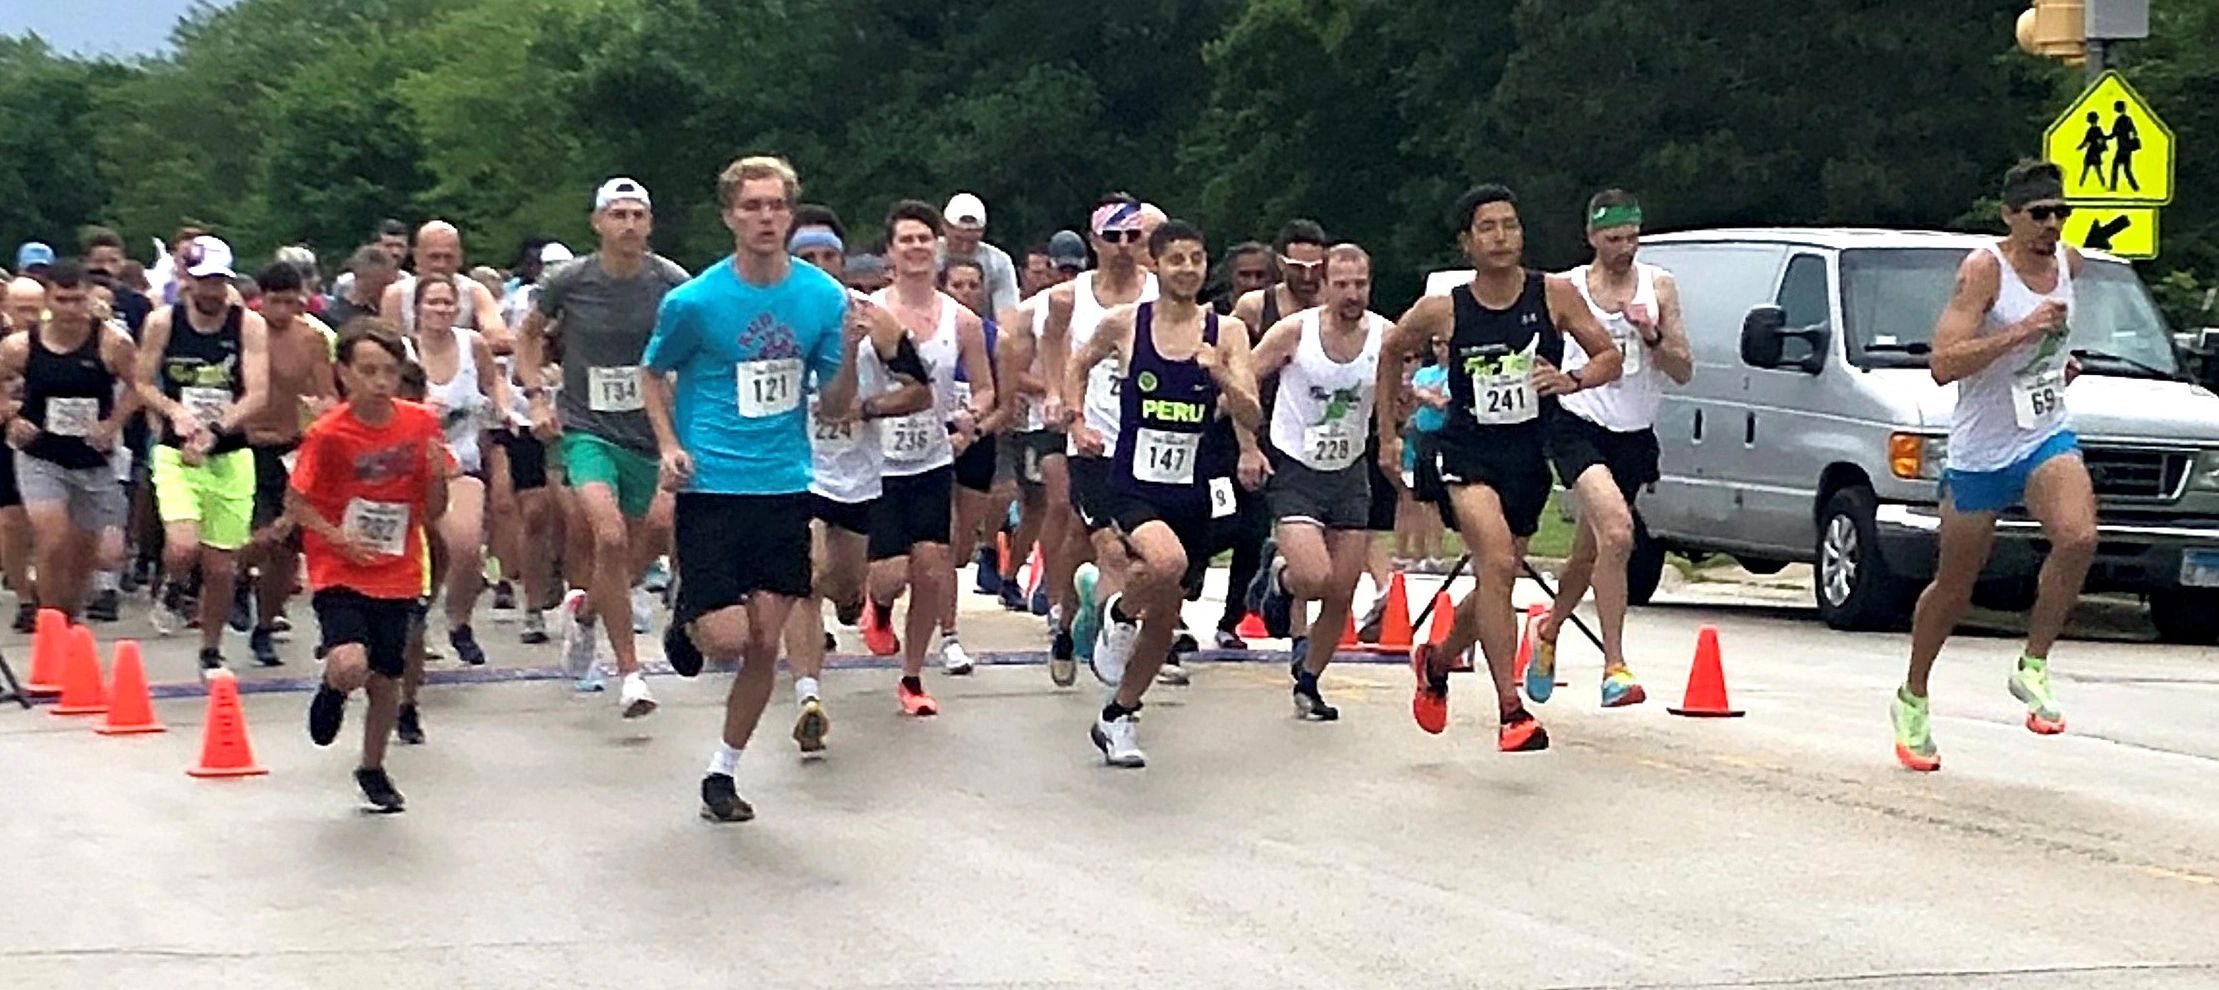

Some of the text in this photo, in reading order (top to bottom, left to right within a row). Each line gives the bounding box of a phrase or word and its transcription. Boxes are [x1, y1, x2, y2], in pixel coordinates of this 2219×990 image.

[753, 374, 786, 402] 121
[1487, 386, 1525, 413] 241
[1142, 400, 1205, 422] PERU
[2031, 388, 2055, 415] 69
[1150, 446, 1186, 471] 147
[1314, 440, 1349, 461] 228
